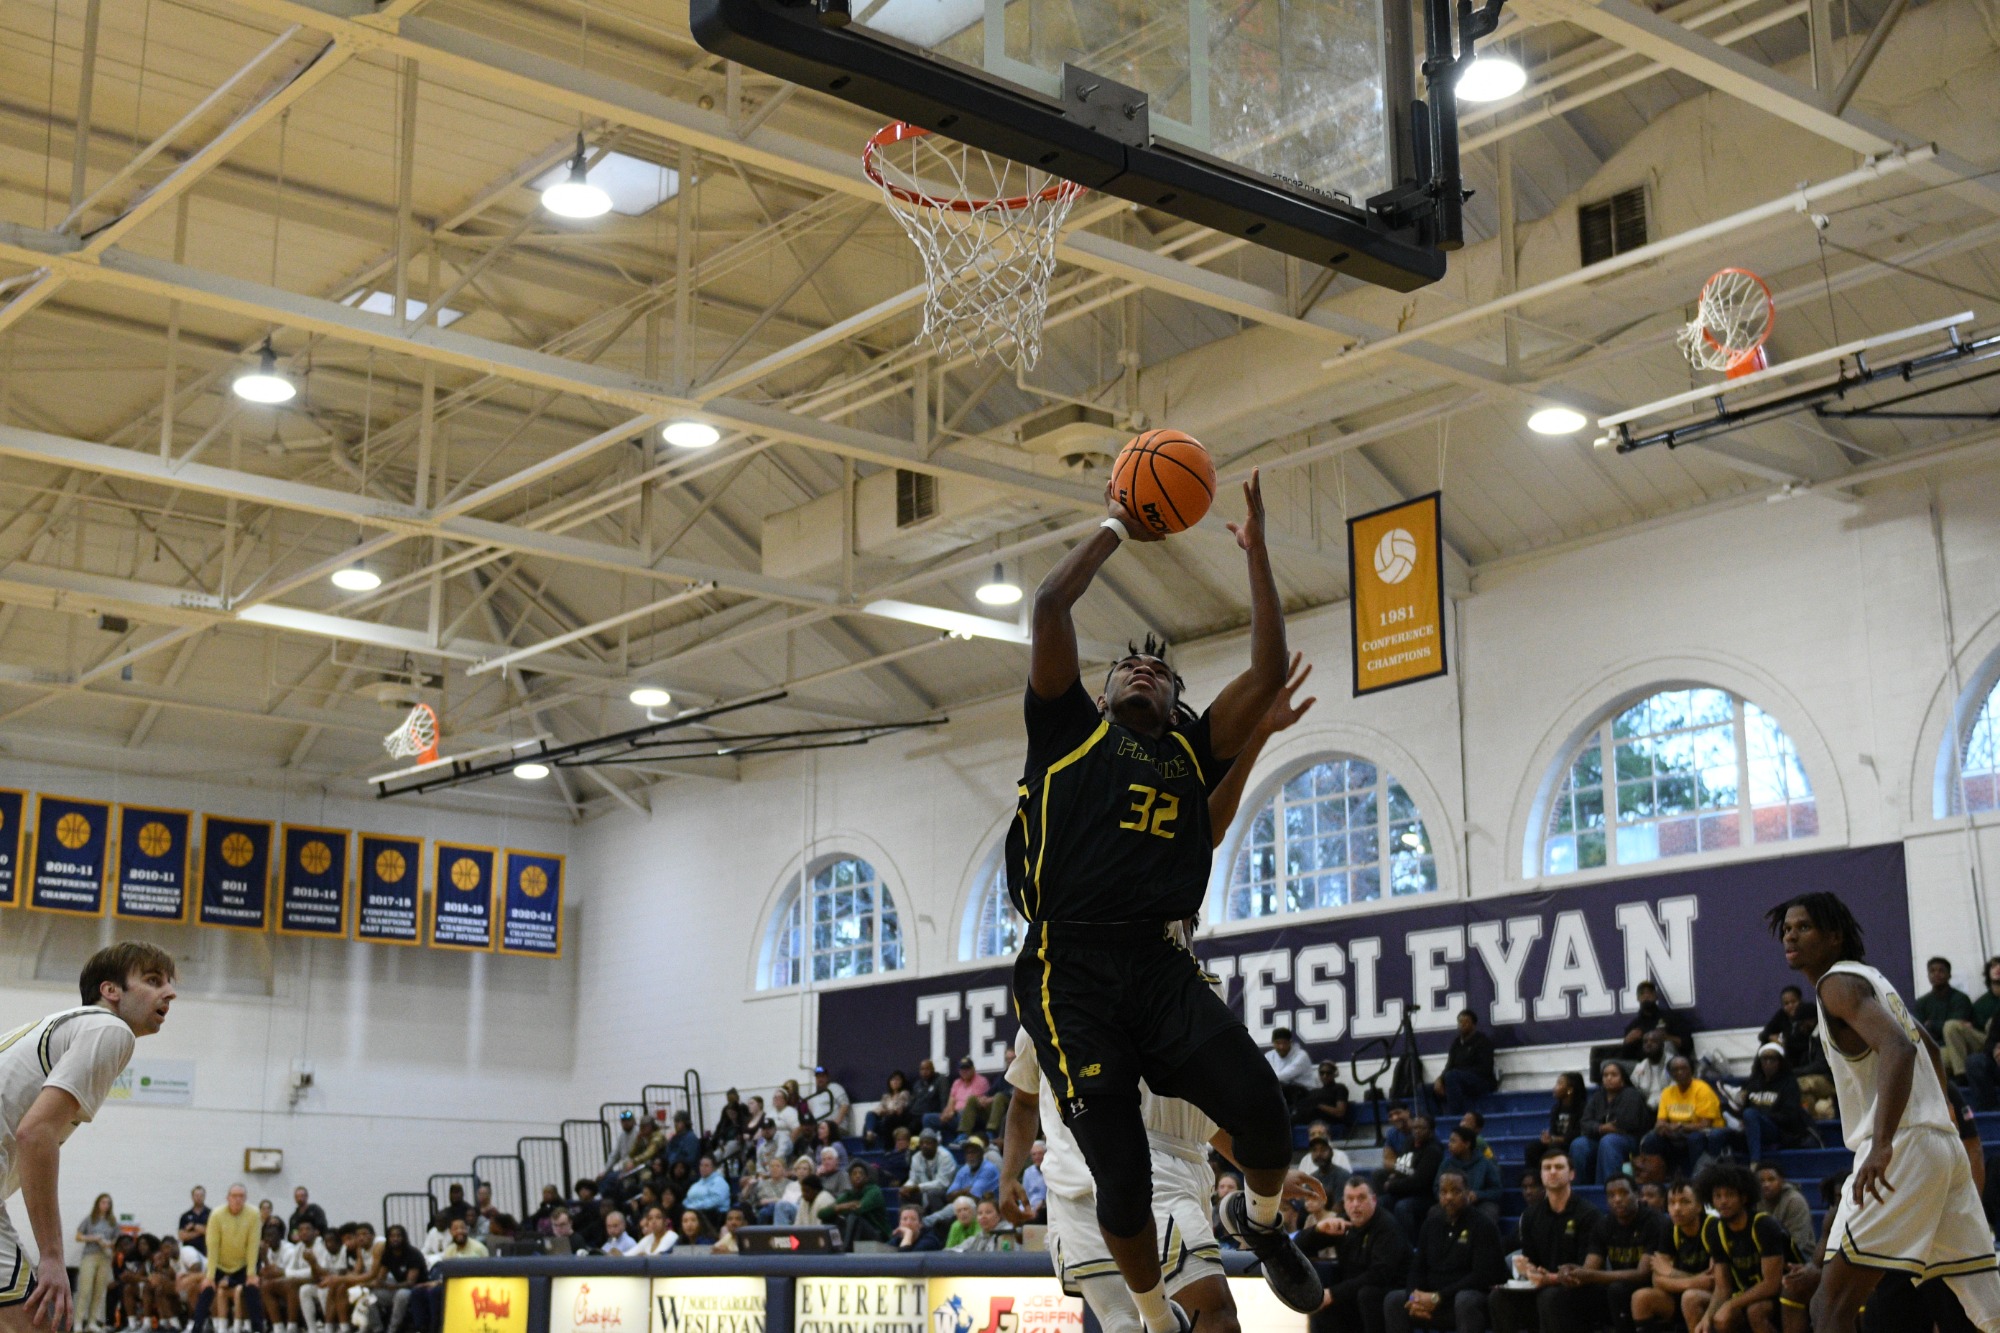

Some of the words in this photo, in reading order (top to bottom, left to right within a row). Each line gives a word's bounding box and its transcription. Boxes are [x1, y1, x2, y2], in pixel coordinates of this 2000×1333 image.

[1380, 605, 1415, 626] 1981
[1362, 624, 1434, 652] CONFERENCE
[1367, 646, 1431, 671] CHAMPIONS
[1120, 784, 1180, 839] 32
[45, 861, 93, 876] 2010-11
[129, 869, 175, 882] 2010-11
[38, 876, 98, 890] CONFERENCE
[122, 883, 180, 895] CONFERENCE
[222, 880, 248, 892] 2011
[40, 889, 94, 903] CHAMPIONS
[121, 892, 181, 905] TOURNAMENT
[292, 886, 337, 900] 2015-16
[222, 895, 245, 905] NCAA
[369, 895, 412, 908] 2017-18
[125, 901, 177, 913] CHAMPIONS
[204, 906, 262, 918] TOURNAMENT
[286, 902, 340, 913] CONFERENCE
[363, 908, 415, 919] CONFERENCE
[444, 901, 485, 915] 2018-19
[289, 914, 336, 925] CHAMPIONS
[366, 916, 412, 927] CHAMPIONS
[437, 915, 488, 927] CONFERENCE
[360, 924, 380, 933] EAST
[381, 926, 417, 936] DIVISION
[440, 923, 485, 934] CHAMPIONS
[507, 921, 555, 933] CONFERENCE
[435, 930, 454, 940] EAST
[455, 932, 489, 943] DIVISION
[509, 929, 552, 940] CHAMPIONS
[916, 985, 1007, 1076] TE
[801, 1284, 926, 1316] EVERETT
[1023, 1294, 1065, 1308] JOEY
[1022, 1310, 1083, 1324] GRIFFIN
